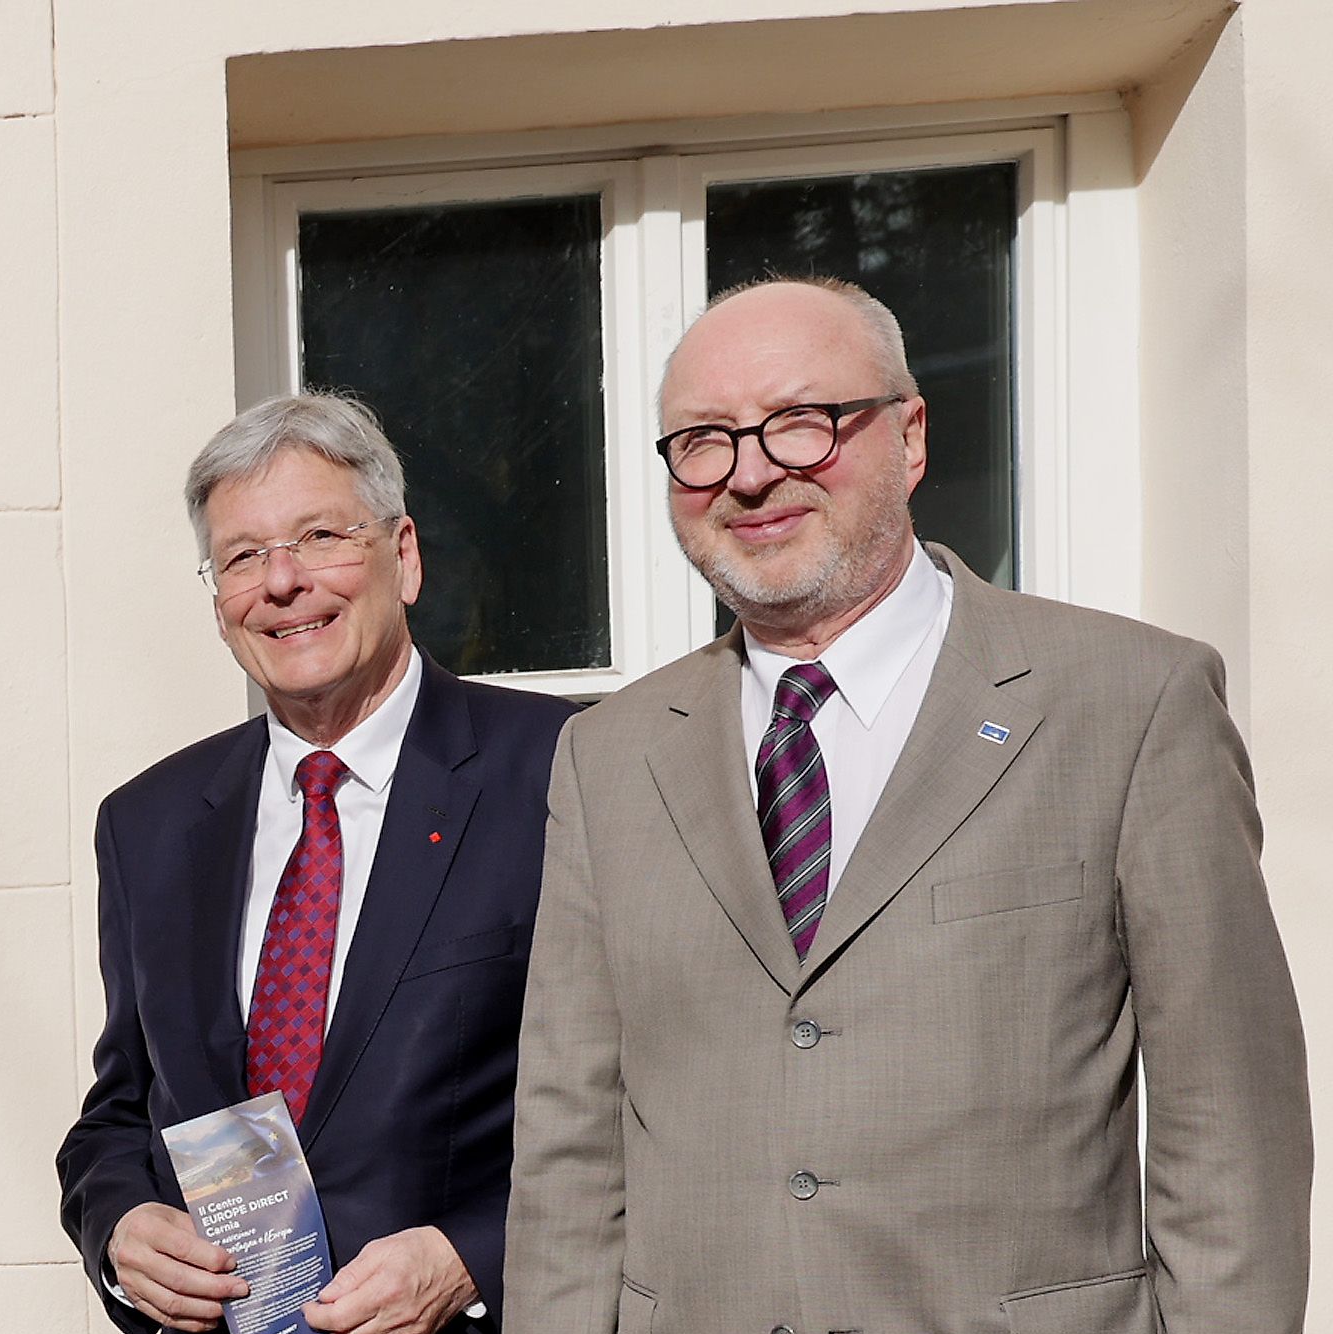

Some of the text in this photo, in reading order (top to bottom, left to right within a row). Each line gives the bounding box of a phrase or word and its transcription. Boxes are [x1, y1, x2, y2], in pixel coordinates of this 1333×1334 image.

[198, 1196, 243, 1216] Il Centro
[202, 1189, 289, 1227] EUROPE DIRECT
[206, 1220, 240, 1237] Carnia
